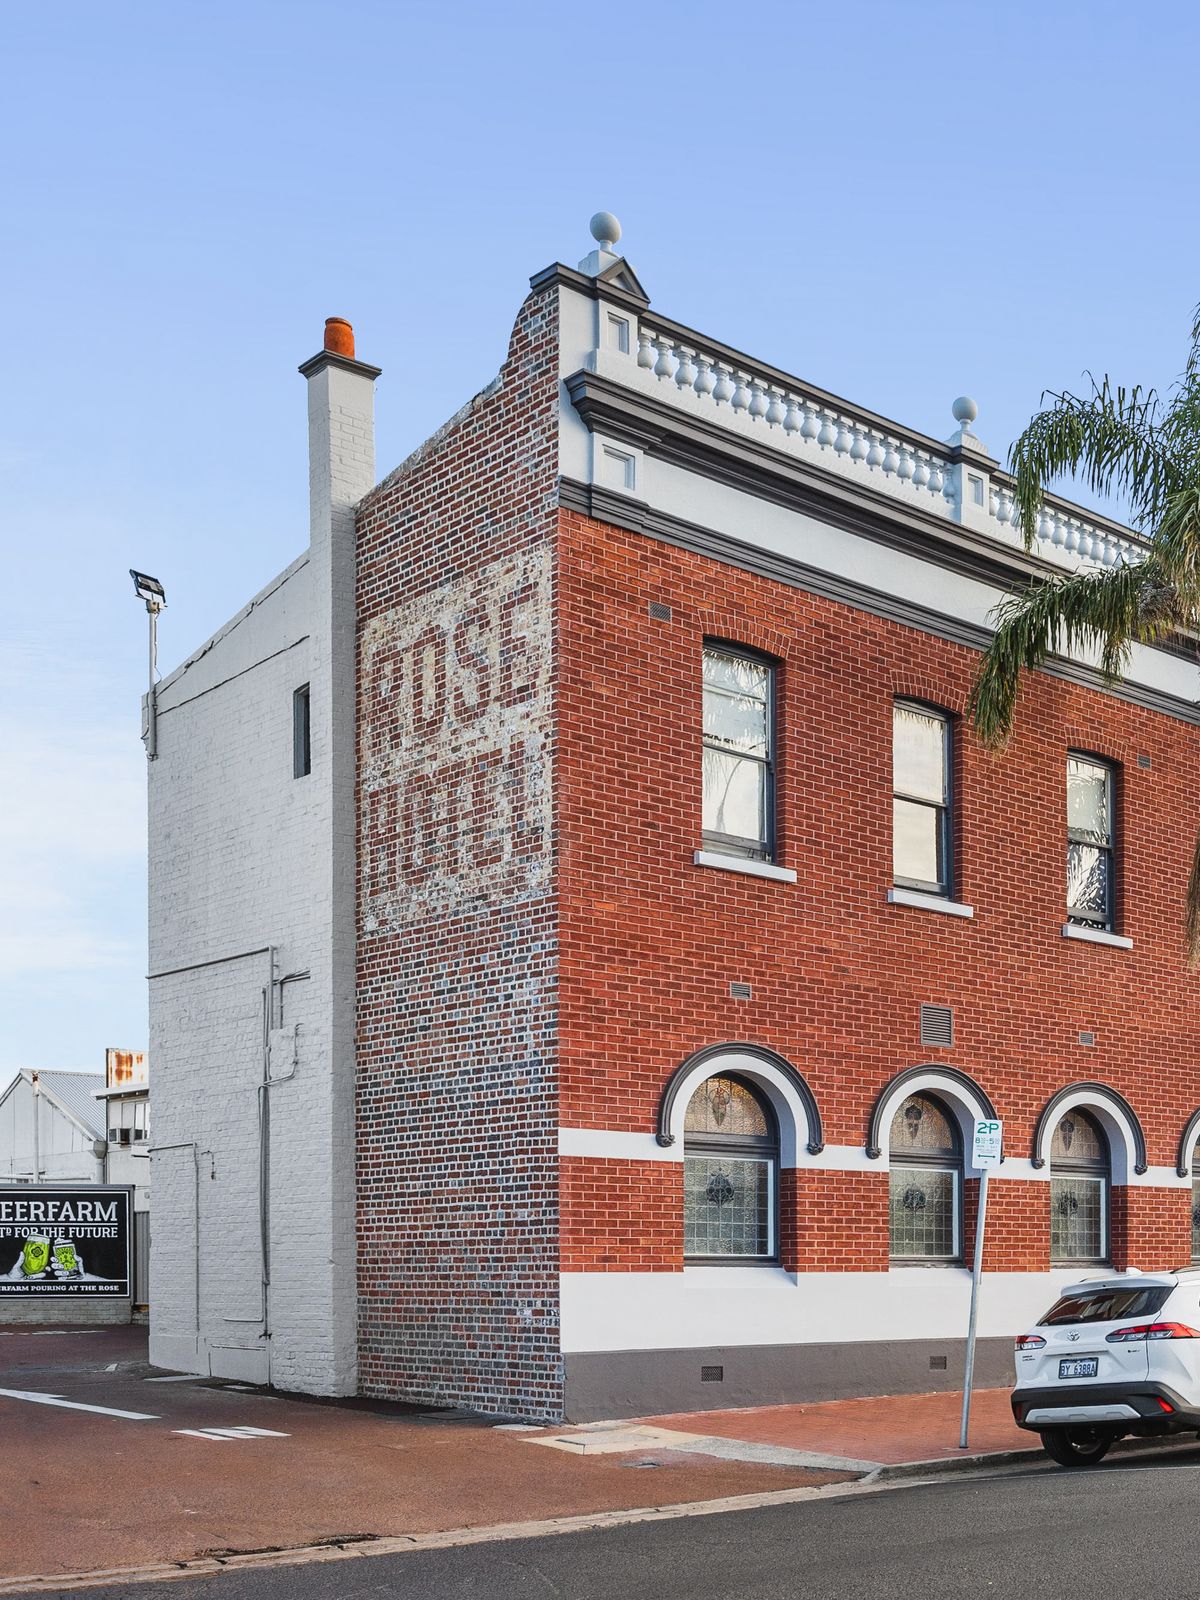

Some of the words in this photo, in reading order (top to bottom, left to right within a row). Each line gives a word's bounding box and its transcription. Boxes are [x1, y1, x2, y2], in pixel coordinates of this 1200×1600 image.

[977, 1122, 999, 1134] 2P
[14, 1227, 38, 1238] FOR
[41, 1227, 66, 1238] THE
[68, 1227, 118, 1238] FUTURE
